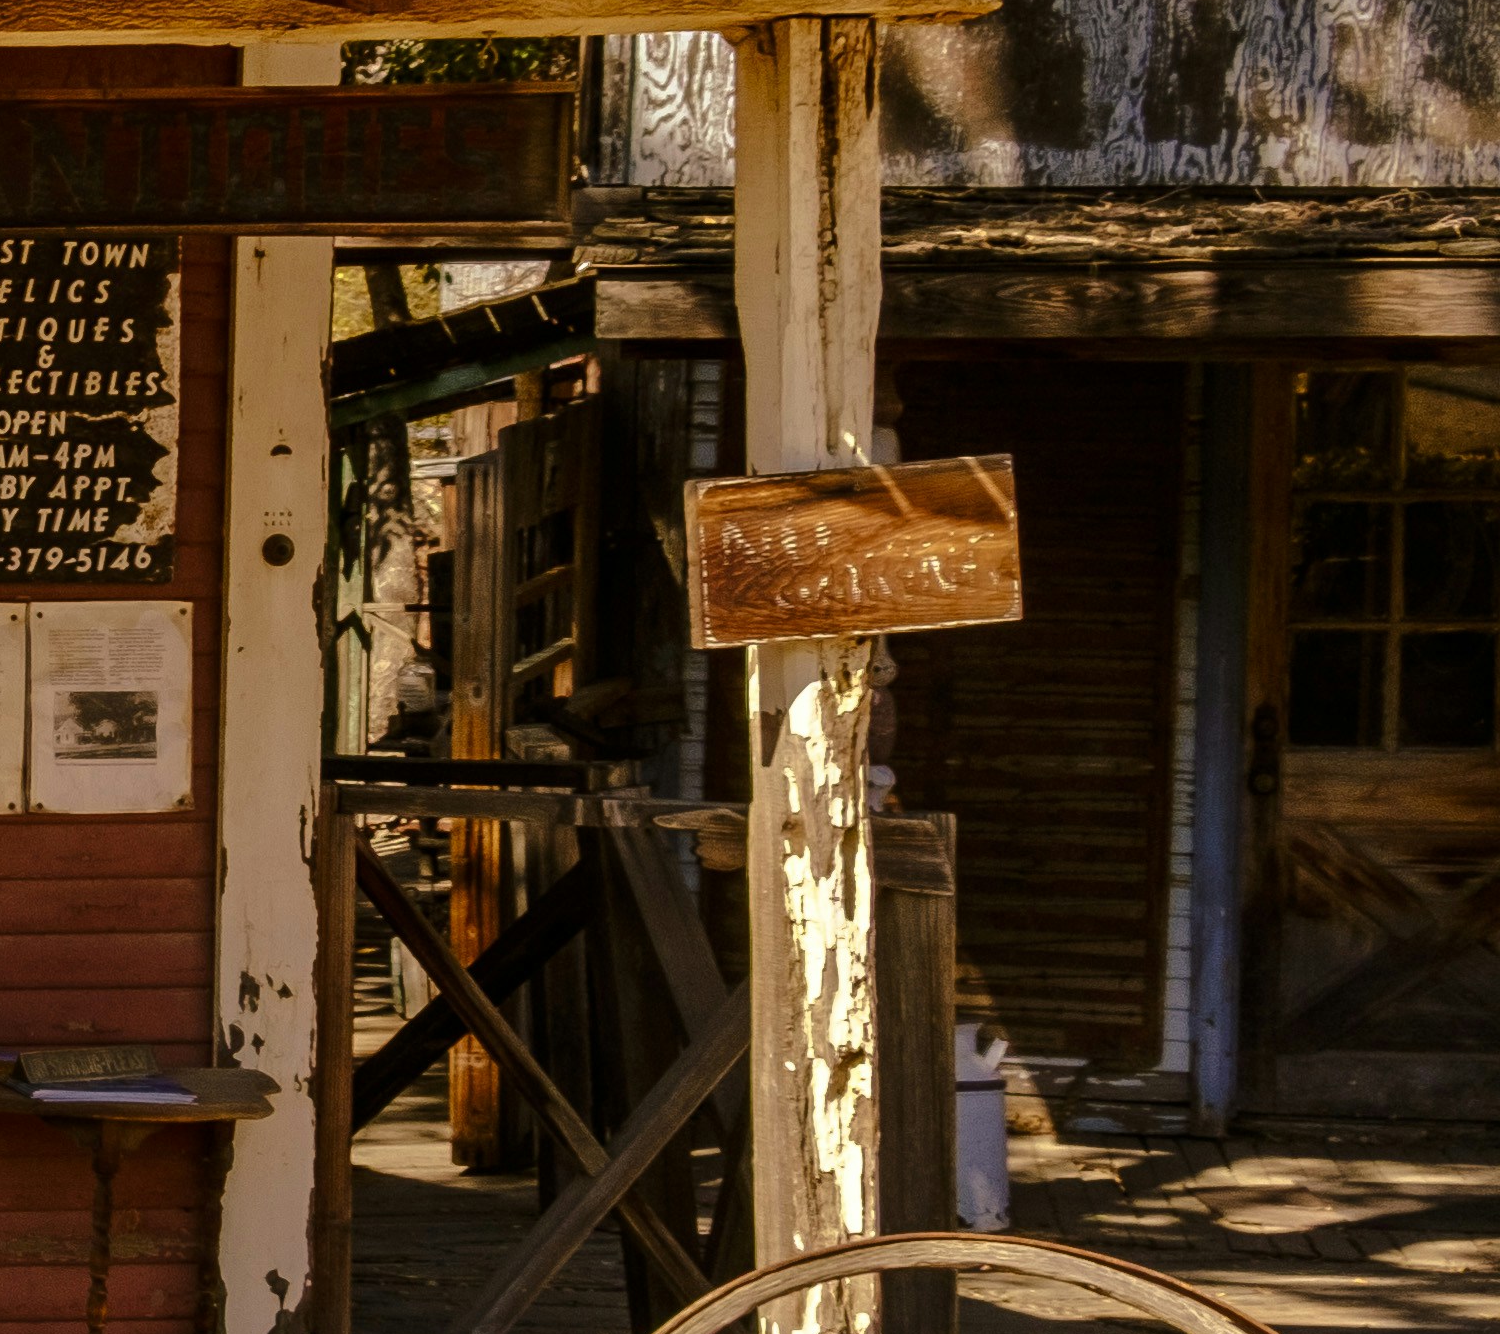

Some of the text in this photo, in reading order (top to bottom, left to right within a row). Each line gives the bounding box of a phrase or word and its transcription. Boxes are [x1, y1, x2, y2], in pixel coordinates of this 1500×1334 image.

[62, 241, 149, 268] TOWN
[37, 344, 55, 369] &
[0, 475, 37, 500] BY
[36, 507, 110, 534] TIME
